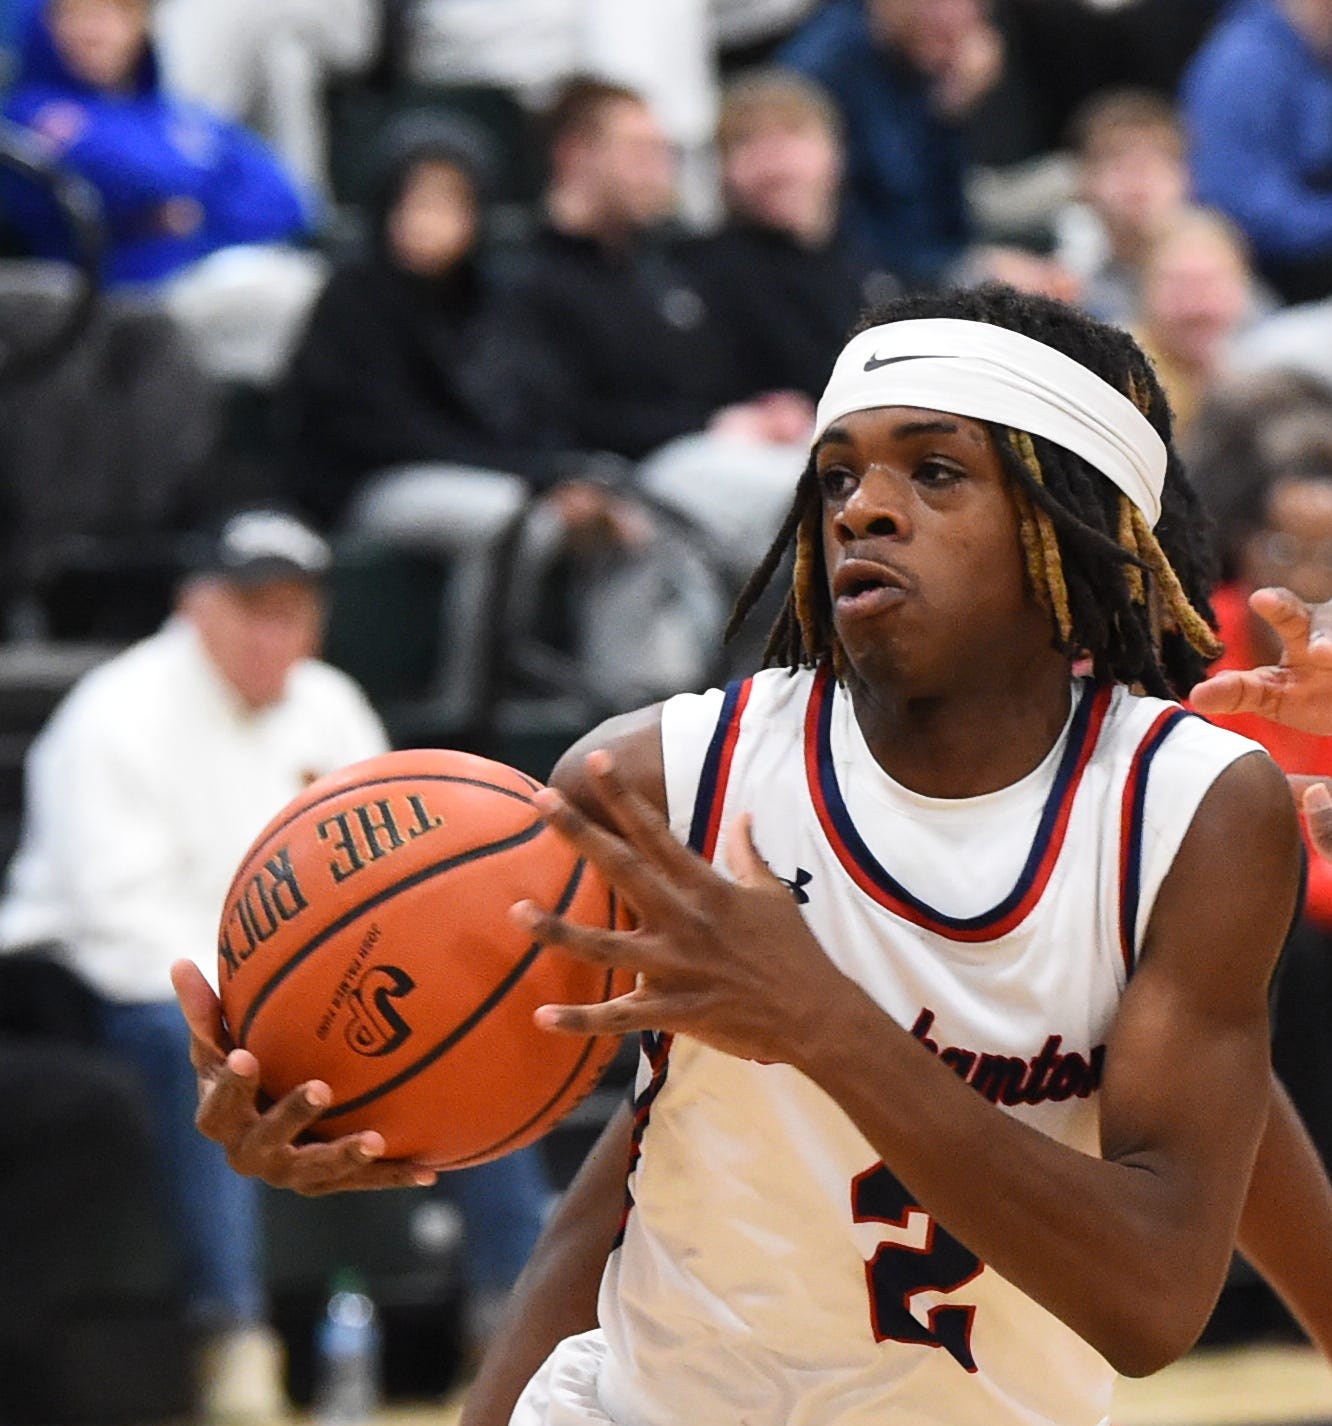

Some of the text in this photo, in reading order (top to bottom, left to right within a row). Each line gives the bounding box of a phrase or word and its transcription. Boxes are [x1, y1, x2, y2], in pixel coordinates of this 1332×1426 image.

[219, 795, 443, 980] THE ROCK
[850, 1160, 986, 1374] 2
